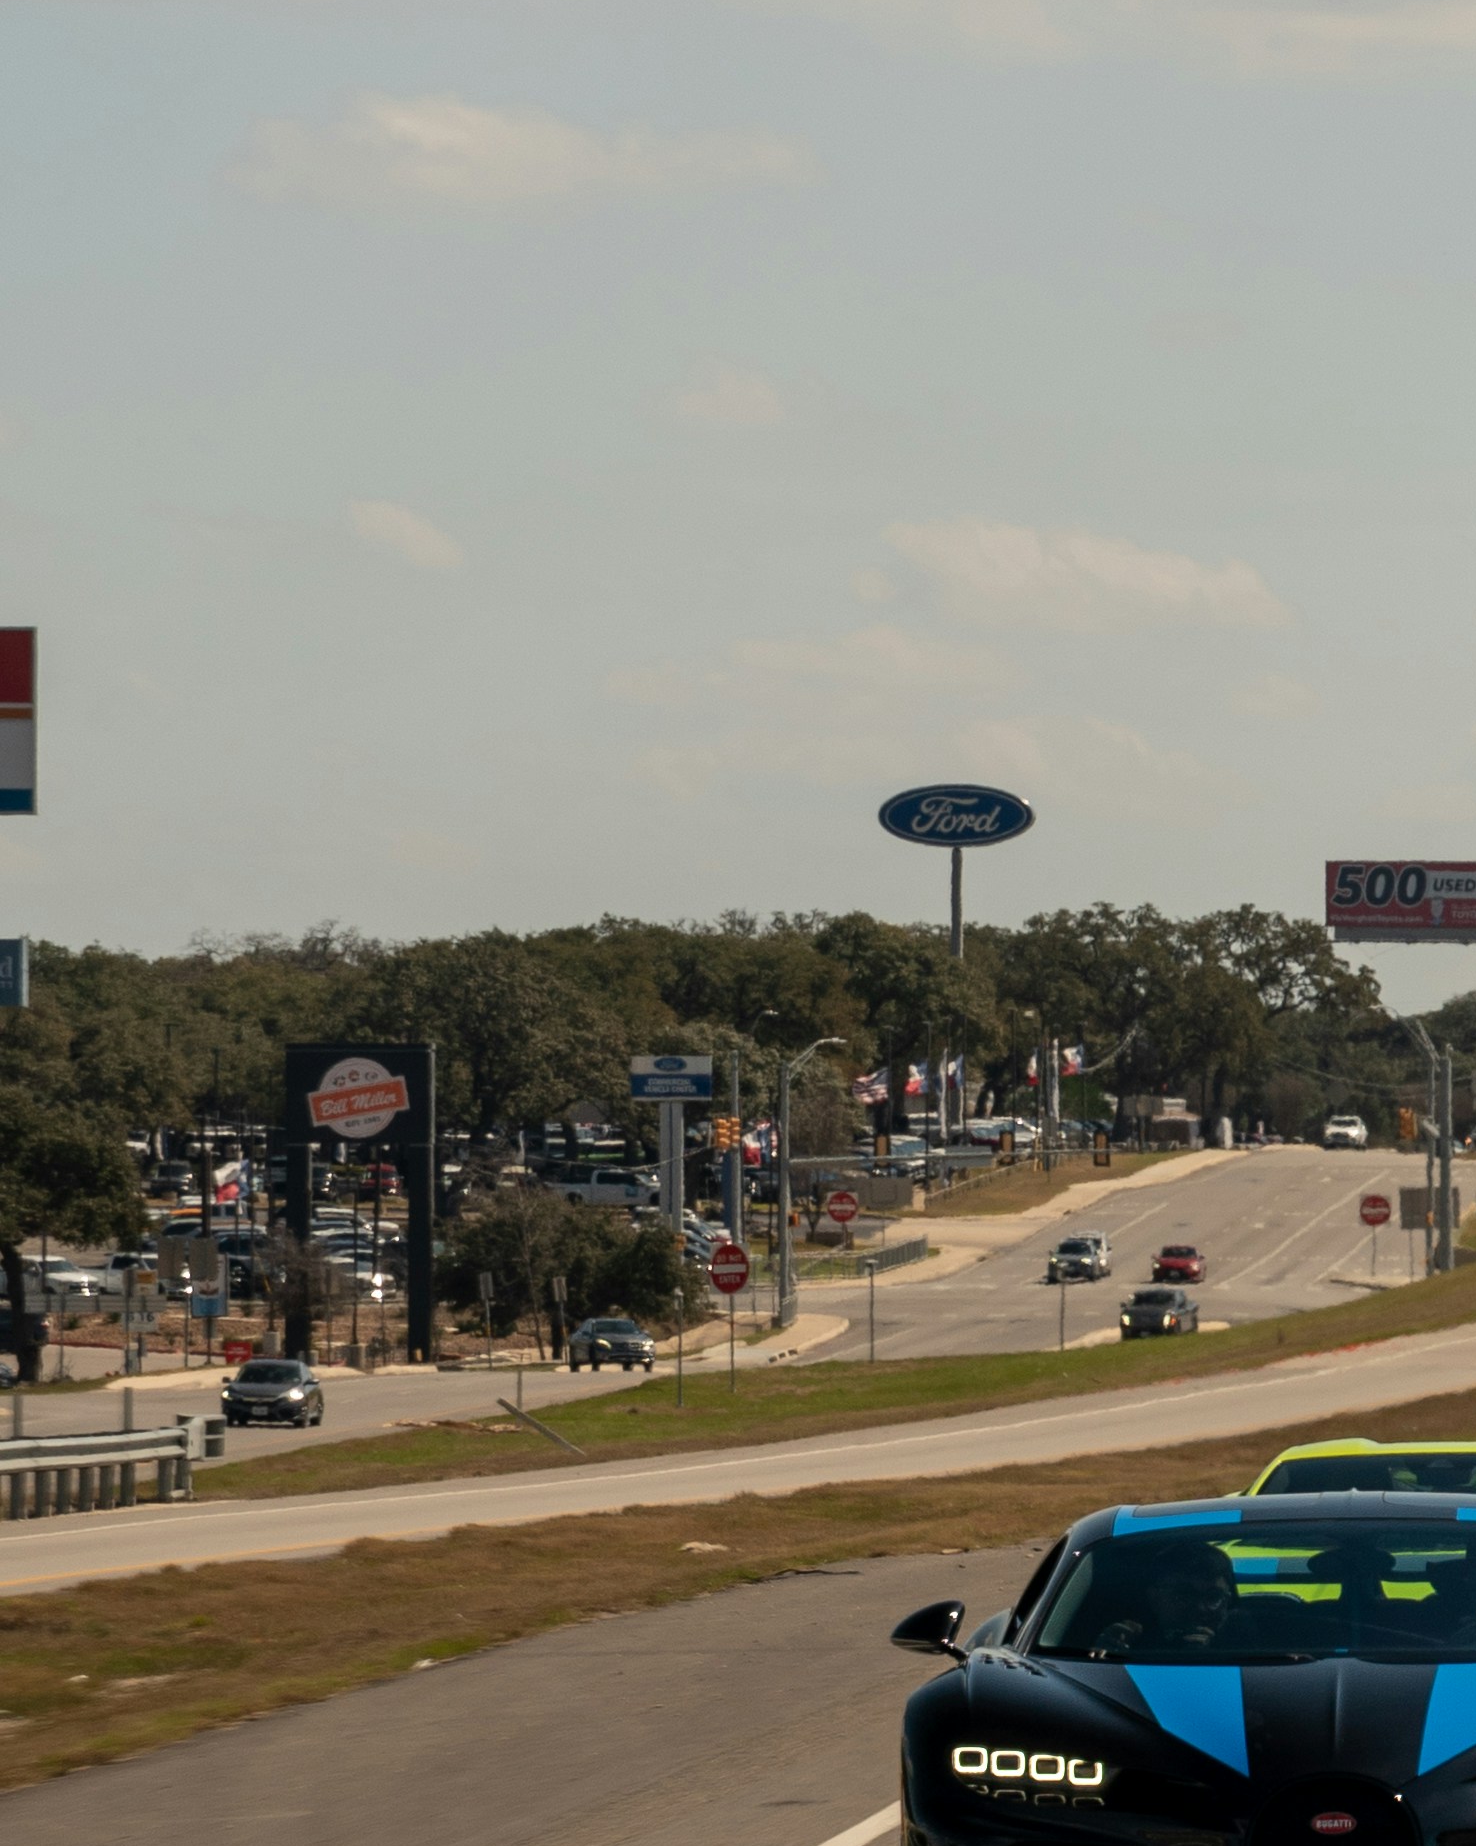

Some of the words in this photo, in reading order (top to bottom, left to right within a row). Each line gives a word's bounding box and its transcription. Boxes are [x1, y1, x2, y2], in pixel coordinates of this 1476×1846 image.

[911, 795, 1002, 833] Ford
[1331, 864, 1427, 908] 500
[1433, 878, 1476, 892] USED
[320, 1098, 348, 1116] Bill
[350, 1091, 397, 1110] Miller
[719, 1275, 741, 1284] ENTER
[1316, 1819, 1352, 1829] BUGATTI
